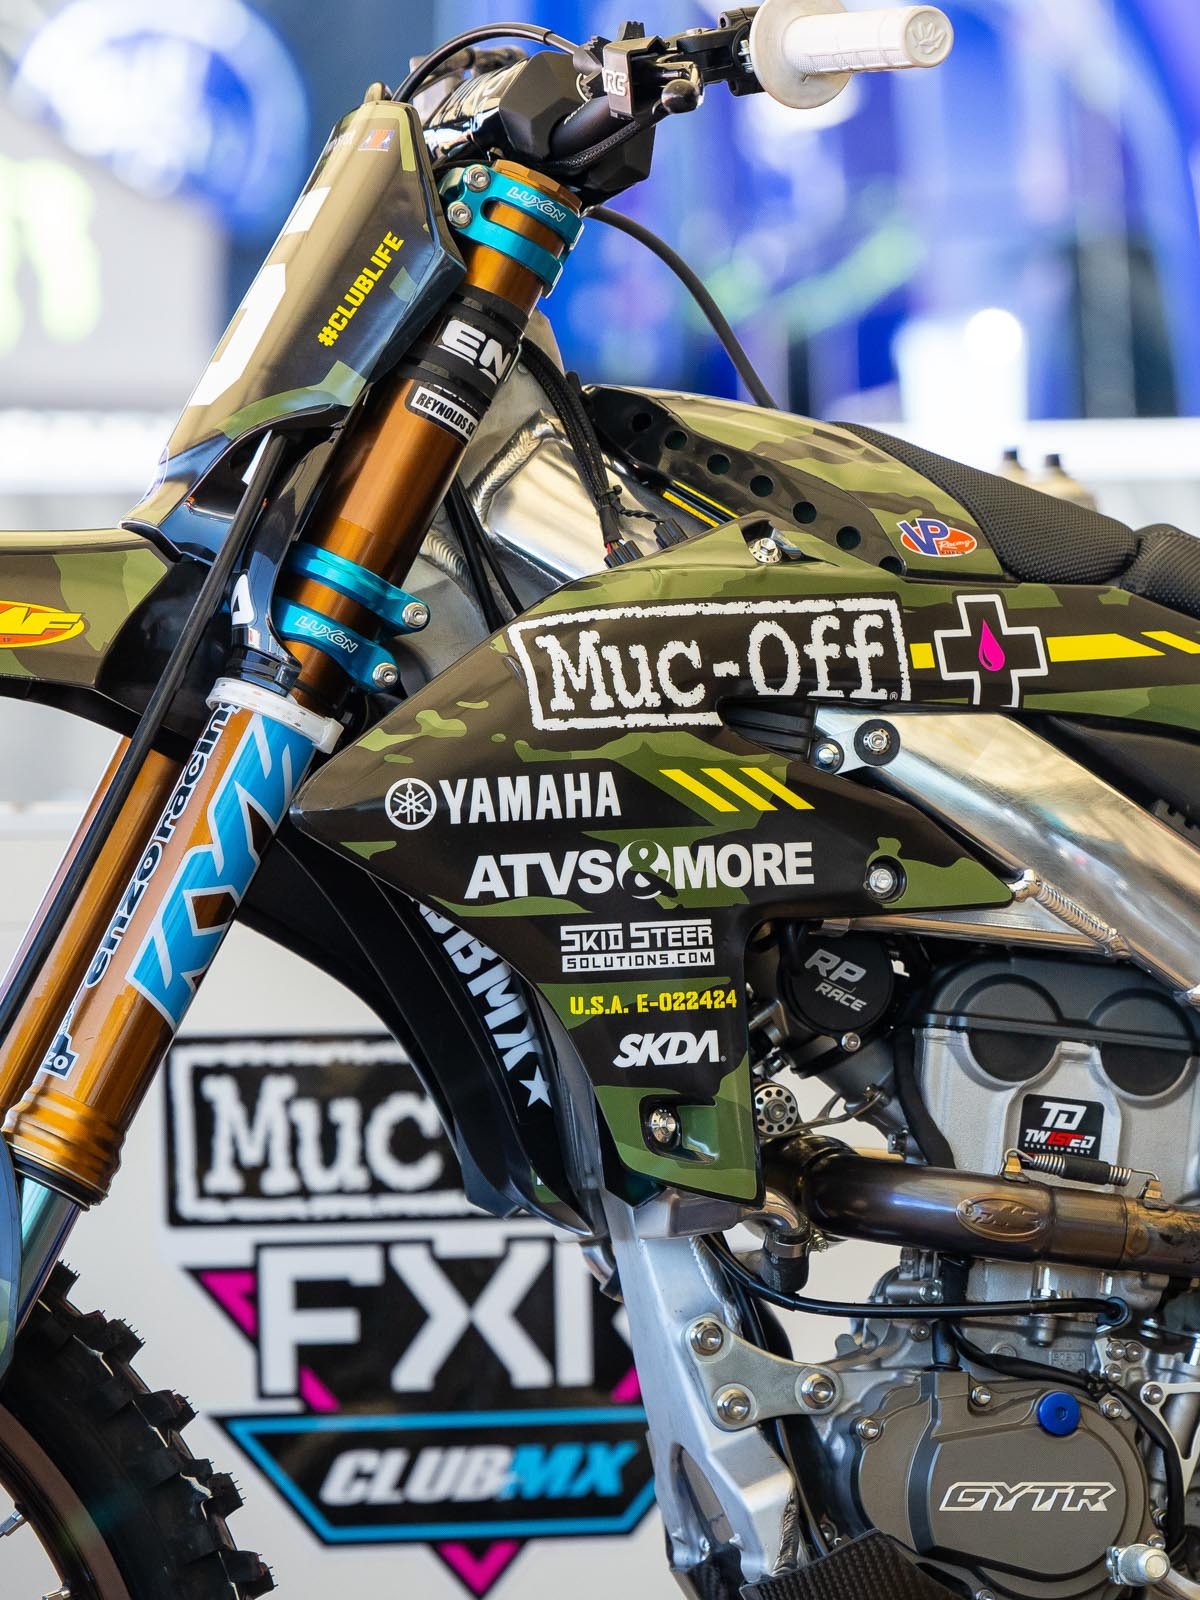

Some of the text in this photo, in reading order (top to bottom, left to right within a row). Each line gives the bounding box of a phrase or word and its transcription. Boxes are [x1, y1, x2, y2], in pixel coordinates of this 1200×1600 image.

[506, 186, 566, 222] LUXON
[317, 231, 404, 346] #CLUBLIFE
[416, 392, 467, 431] REYNOLDS
[896, 518, 950, 557] VP
[295, 615, 358, 653] LUXON
[535, 613, 886, 712] Muc-Off
[439, 771, 623, 825] YAMAHA
[560, 919, 713, 952] SKID STEER
[567, 951, 712, 970] SOLUTIONS.COM
[804, 948, 867, 982] RP
[570, 989, 738, 1015] U.S.A. E-022424
[815, 982, 867, 1011] RACE
[612, 1030, 720, 1068] SKDA
[1040, 1101, 1087, 1131] TD
[319, 1442, 638, 1507] CLUBMX
[939, 1481, 1117, 1512] GYTR
